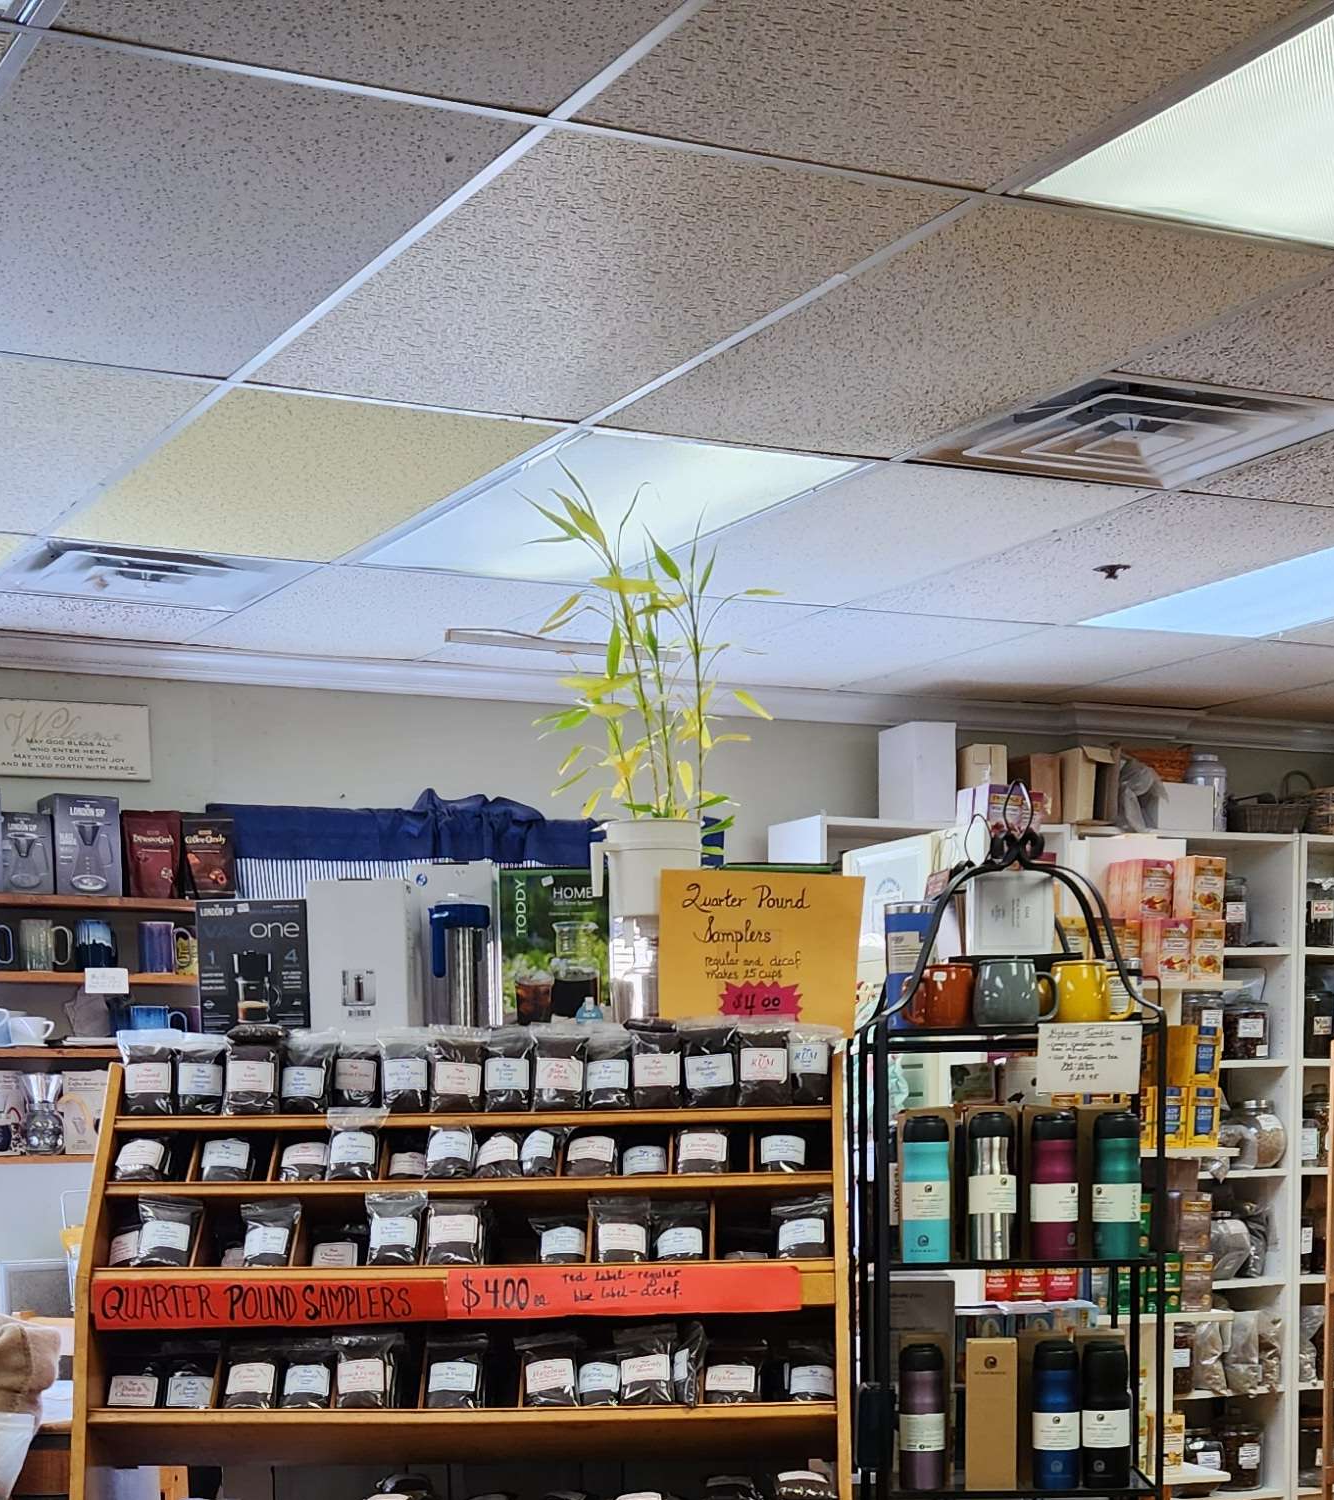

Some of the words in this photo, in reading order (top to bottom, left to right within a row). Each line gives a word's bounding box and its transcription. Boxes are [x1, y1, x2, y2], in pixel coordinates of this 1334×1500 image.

[4, 707, 123, 747] Welcome
[69, 807, 95, 816] LONDON
[7, 823, 28, 831] LONDON
[552, 887, 593, 899] HOME
[683, 883, 746, 913] Quarter
[753, 885, 810, 909] Pound
[200, 907, 224, 917] LONDON
[225, 907, 234, 916] SIP
[515, 879, 527, 937] TODDY
[249, 922, 300, 938] one
[693, 916, 772, 953] Samplers
[208, 950, 215, 965] 1
[284, 948, 298, 962] 4
[705, 951, 739, 971] regular
[743, 957, 763, 966] and
[769, 951, 802, 969] decaf
[706, 968, 739, 980] makes
[758, 969, 783, 980] cups
[751, 1056, 776, 1068] RUM
[561, 1273, 587, 1284] red
[101, 1284, 220, 1321] QUARTER
[223, 1284, 298, 1321] POUND
[302, 1284, 412, 1321] SAMPLERS
